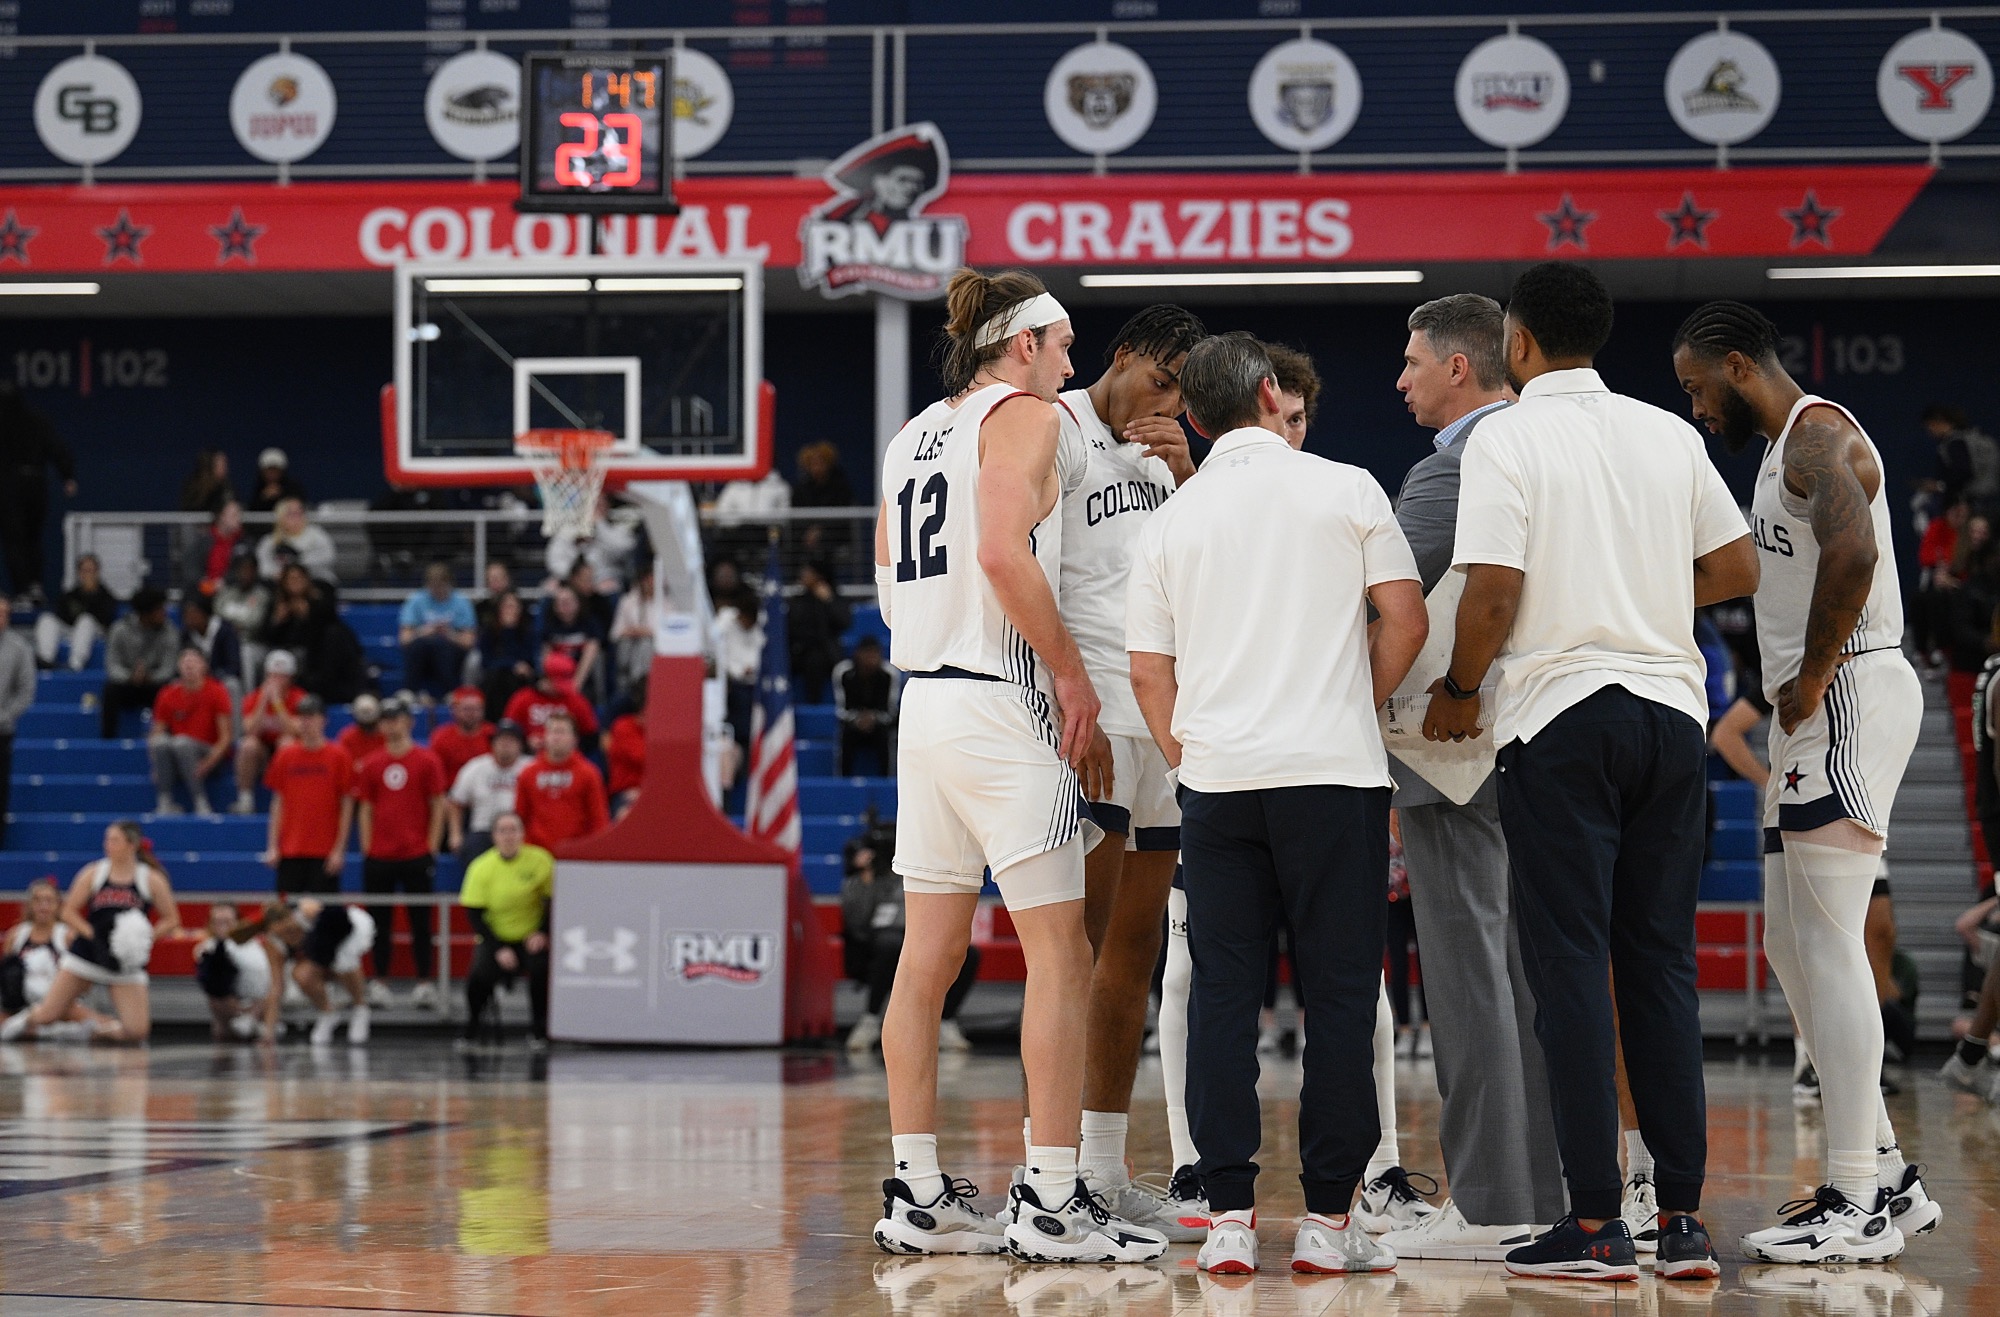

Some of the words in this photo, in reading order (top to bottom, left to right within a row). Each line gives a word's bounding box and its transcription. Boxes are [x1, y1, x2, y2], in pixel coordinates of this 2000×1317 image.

[57, 84, 120, 135] GB
[1896, 61, 1976, 111] Y
[554, 112, 643, 187] 23
[358, 205, 769, 266] COLONIAL
[1005, 199, 1354, 261] CRAZIES
[806, 218, 963, 280] RMU
[15, 350, 71, 387] 101
[101, 350, 168, 387] 102
[1833, 335, 1904, 374] 103
[914, 427, 953, 461] LAST
[896, 471, 948, 583] 12
[1087, 480, 1176, 527] COLONIA
[1751, 513, 1794, 557] ALS
[673, 935, 771, 973] RMU
